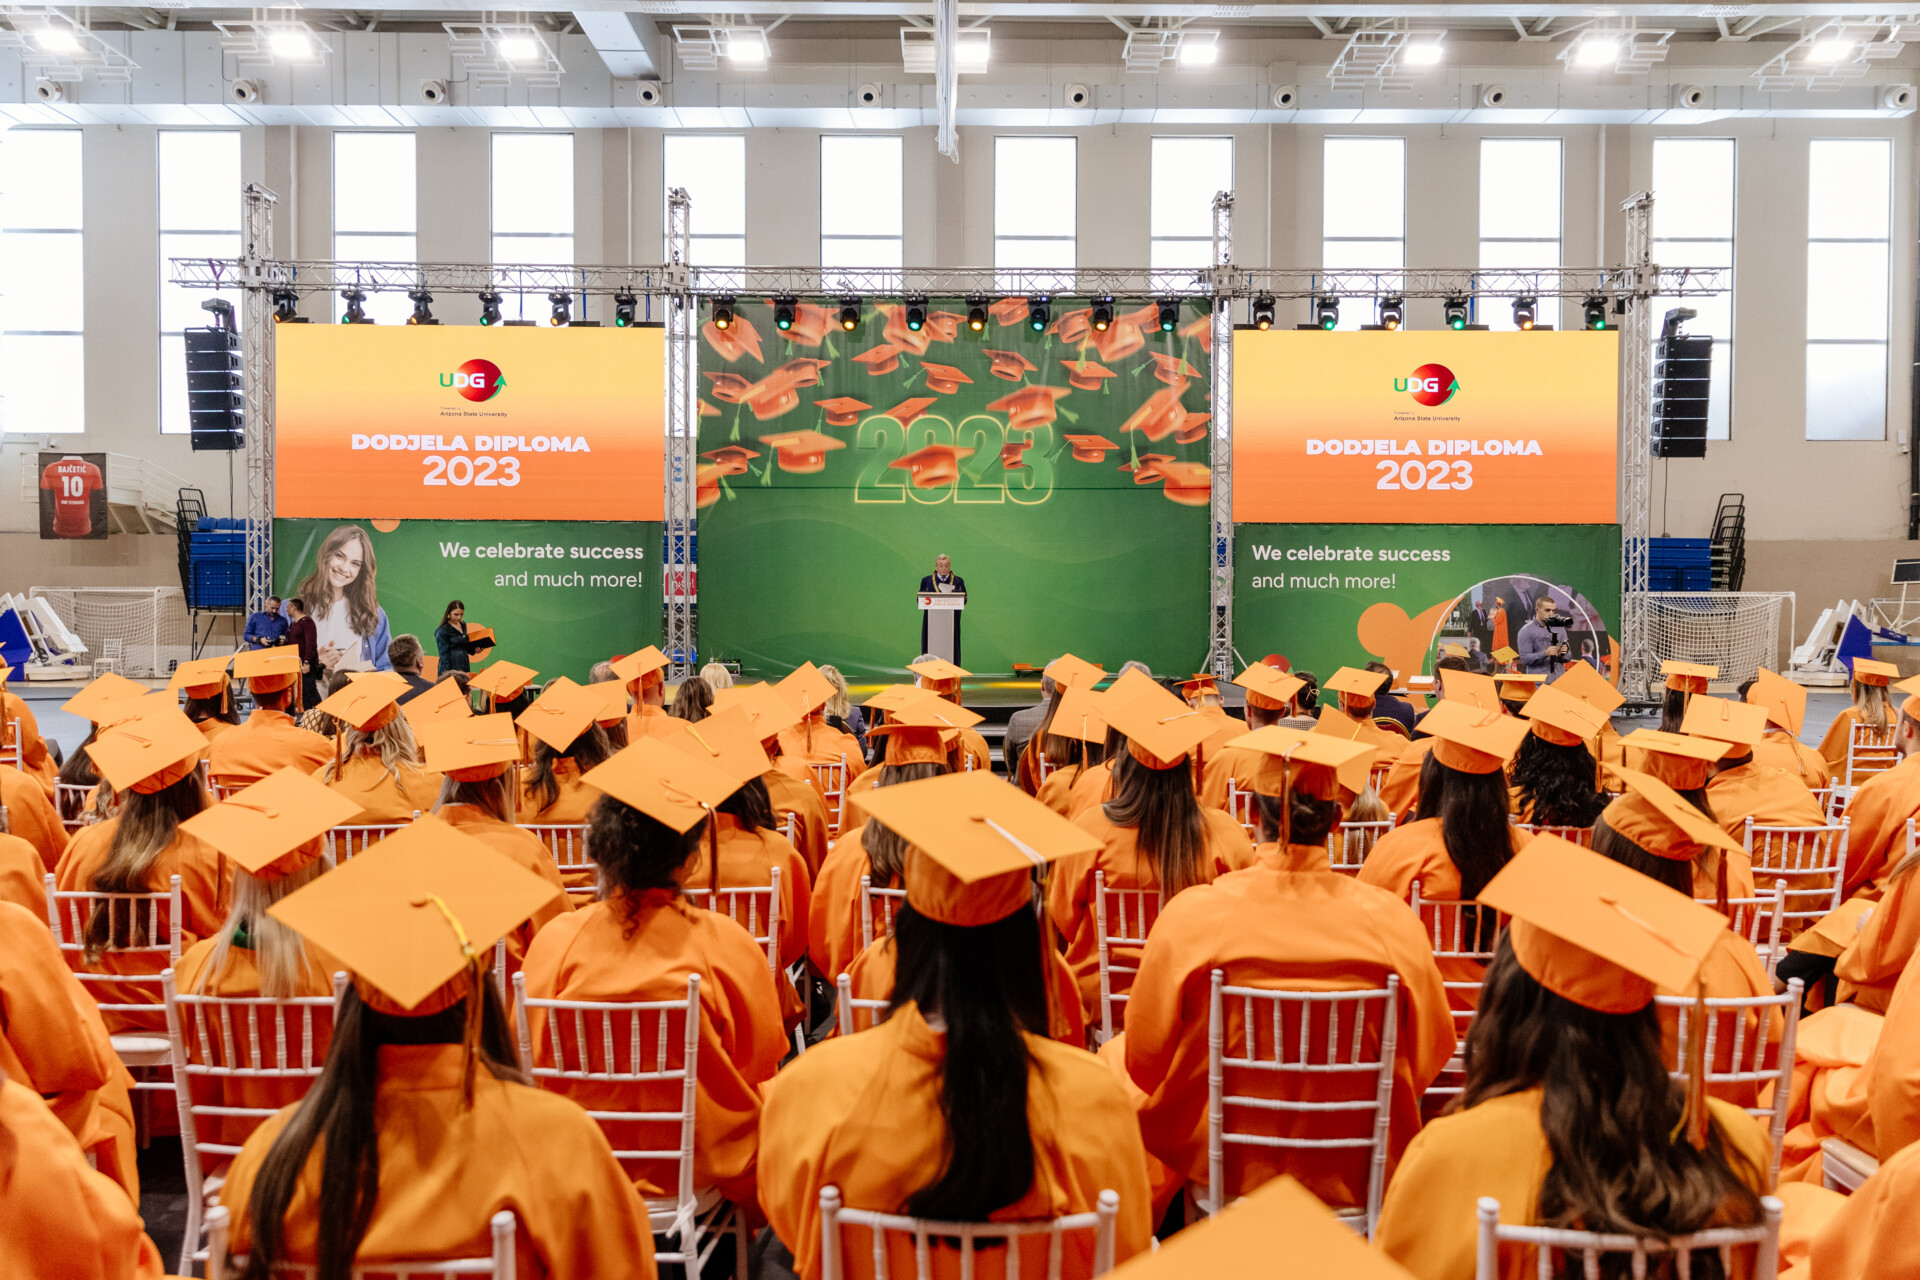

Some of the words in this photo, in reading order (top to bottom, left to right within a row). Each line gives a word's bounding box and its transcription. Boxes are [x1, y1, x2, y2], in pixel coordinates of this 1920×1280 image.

[439, 372, 485, 389] UDG
[1394, 377, 1439, 393] UDG
[351, 433, 469, 451] DODJELA
[475, 435, 591, 453] DIPLOMA
[1306, 438, 1422, 455] DODJELA
[1428, 439, 1543, 456] DIPLOMA
[854, 415, 1053, 505] 2023
[423, 455, 521, 487] 2023
[1376, 459, 1473, 491] 2023
[61, 475, 84, 498] 10
[439, 541, 471, 559] We
[475, 542, 565, 559] celebrate
[570, 546, 644, 560] success
[1252, 544, 1282, 561] We
[1286, 545, 1374, 562] celebrate
[1378, 549, 1451, 562] success
[494, 570, 528, 587] and
[533, 570, 585, 587] much
[590, 571, 642, 588] more!
[1252, 572, 1284, 589] and
[1290, 572, 1340, 589] much
[1346, 573, 1396, 589] more!
